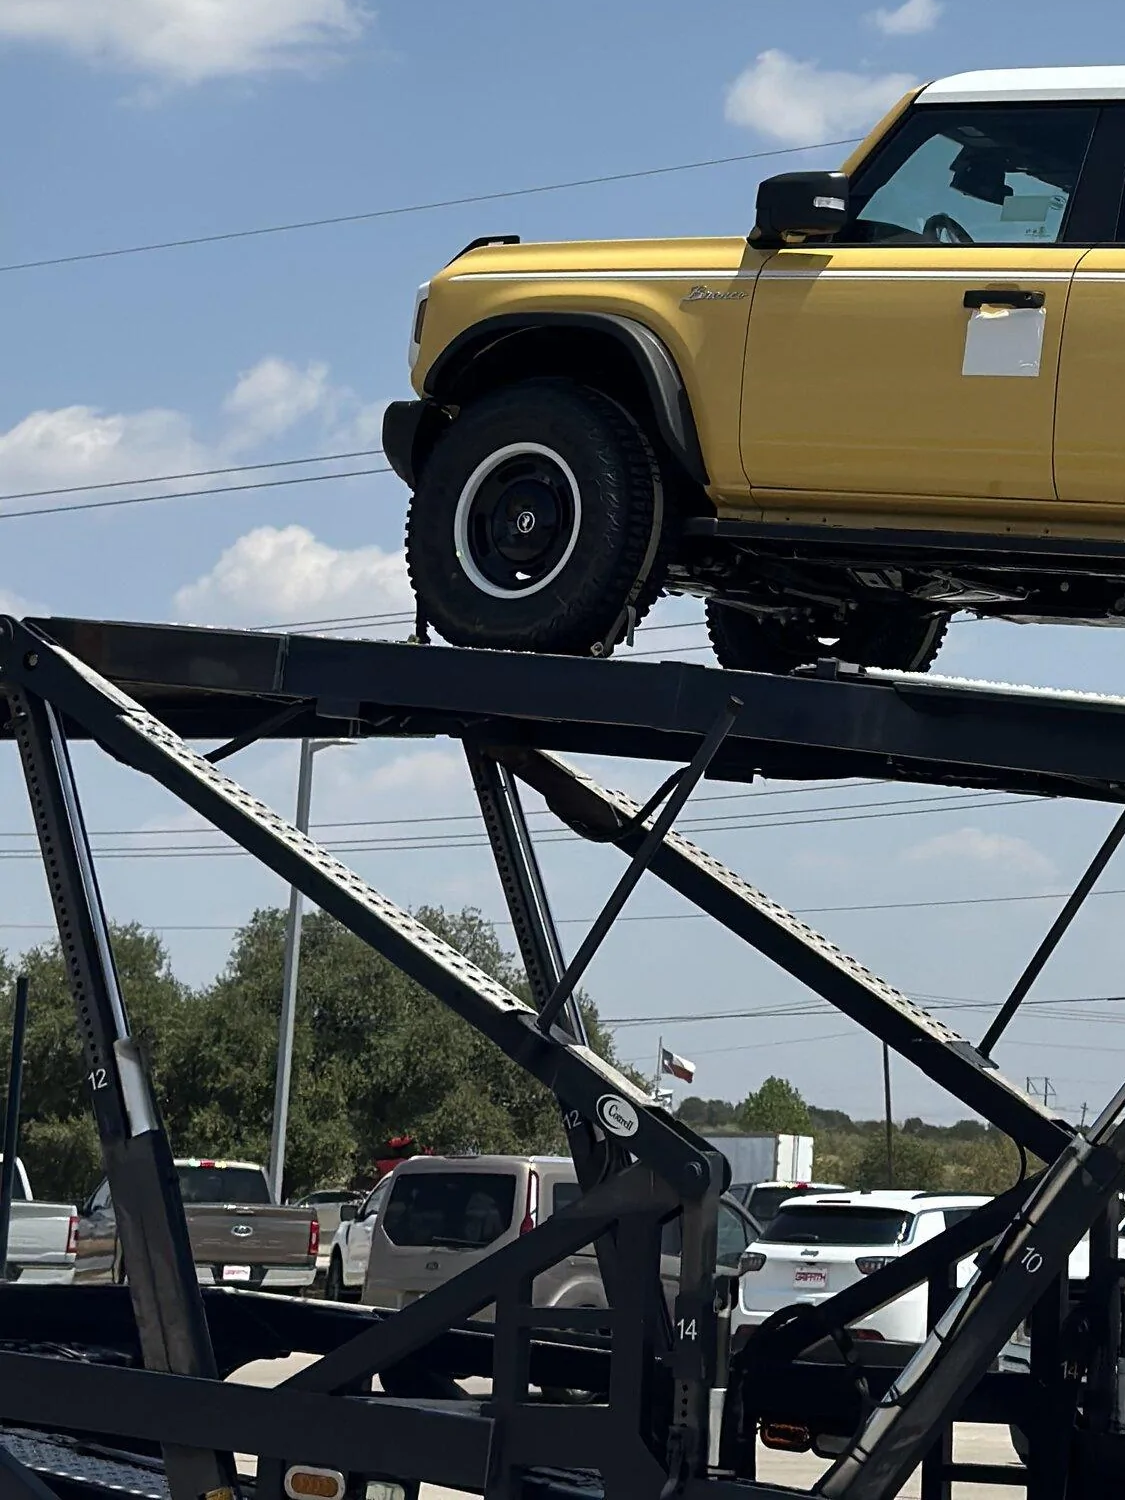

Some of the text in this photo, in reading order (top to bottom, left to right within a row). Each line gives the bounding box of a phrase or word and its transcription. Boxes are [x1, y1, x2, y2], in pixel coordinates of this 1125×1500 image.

[682, 285, 749, 301] Bronco
[88, 1068, 108, 1090] 12
[563, 1109, 582, 1130] 12
[1021, 1246, 1043, 1273] 10
[677, 1318, 698, 1340] 14
